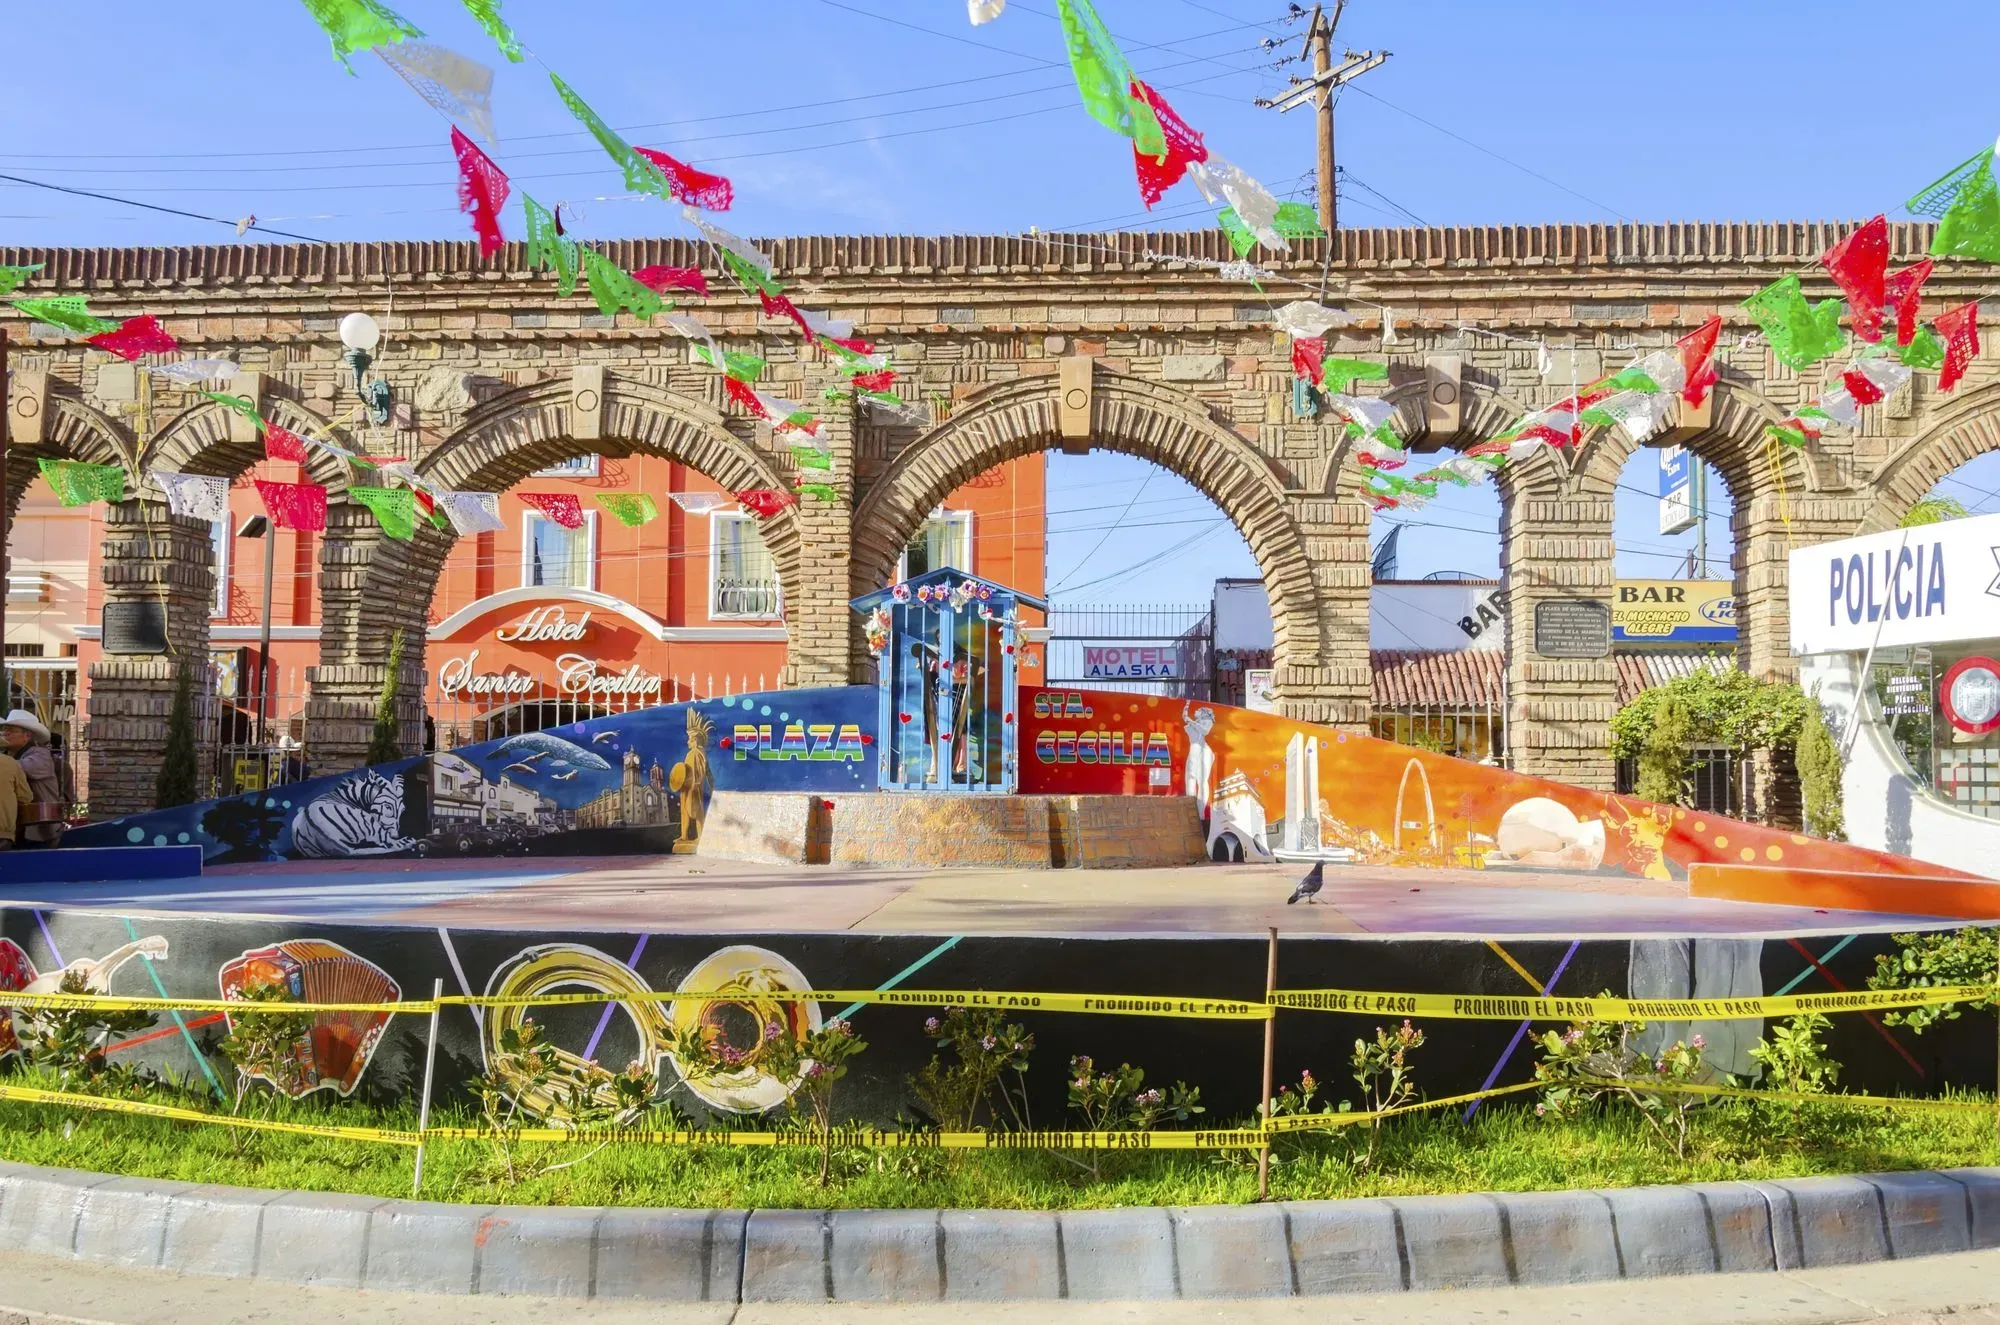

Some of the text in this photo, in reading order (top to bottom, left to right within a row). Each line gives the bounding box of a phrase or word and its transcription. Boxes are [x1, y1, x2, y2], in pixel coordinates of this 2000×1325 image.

[1668, 492, 1682, 509] BAR
[1830, 541, 1946, 627] POLICIA
[1619, 586, 1686, 602] BAR
[496, 605, 591, 641] Hotel
[1457, 590, 1506, 640] BAR
[1612, 610, 1625, 622] EL
[1626, 610, 1690, 622] MUCHACHO
[1708, 610, 1736, 619] LIG
[1627, 622, 1672, 635] ALEGRE
[1087, 648, 1175, 664] MOTEL
[439, 649, 662, 700] Santa Cecilia
[1091, 664, 1170, 676] ALASKA
[1034, 692, 1094, 719] STA.
[733, 724, 864, 761] PLAZA
[1035, 730, 1171, 765] CECILIA
[1353, 995, 1371, 1011] EL
[1376, 995, 1416, 1012] PASO
[1453, 998, 1595, 1017] PROHIBIDO EL PASO
[1627, 1001, 1765, 1017] PROHIBIDO EL PASO
[985, 1132, 1151, 1148] PROHIBIDO EL PASO
[1195, 1132, 1271, 1147] PROHIBID
